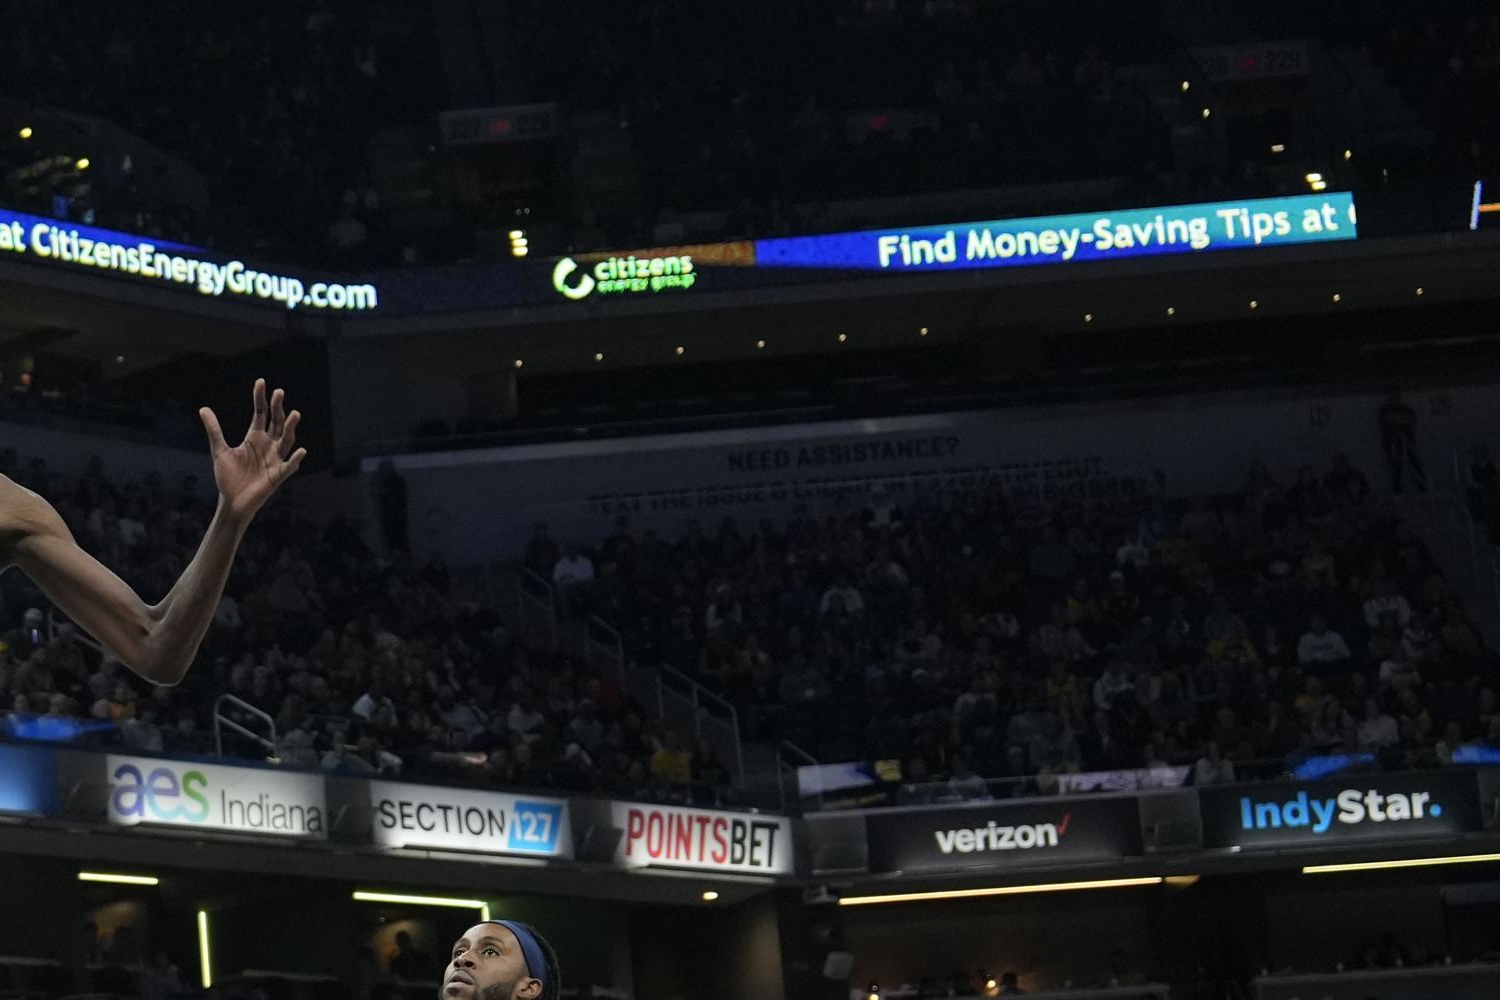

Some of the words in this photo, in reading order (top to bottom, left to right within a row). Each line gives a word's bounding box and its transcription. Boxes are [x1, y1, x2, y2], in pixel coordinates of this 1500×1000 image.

[878, 231, 956, 267] Find
[966, 214, 1209, 261] Money-Saving
[1217, 208, 1290, 244] Tips
[1302, 205, 1337, 233] at
[32, 224, 377, 310] CitizensEnergyGroup.com
[594, 256, 693, 281] citizens
[728, 449, 790, 472] NEED
[110, 766, 208, 823] aes
[220, 789, 323, 833] Indiana
[379, 799, 505, 836] SECTION
[626, 809, 782, 868] POINTSBET
[935, 821, 1059, 853] verizon
